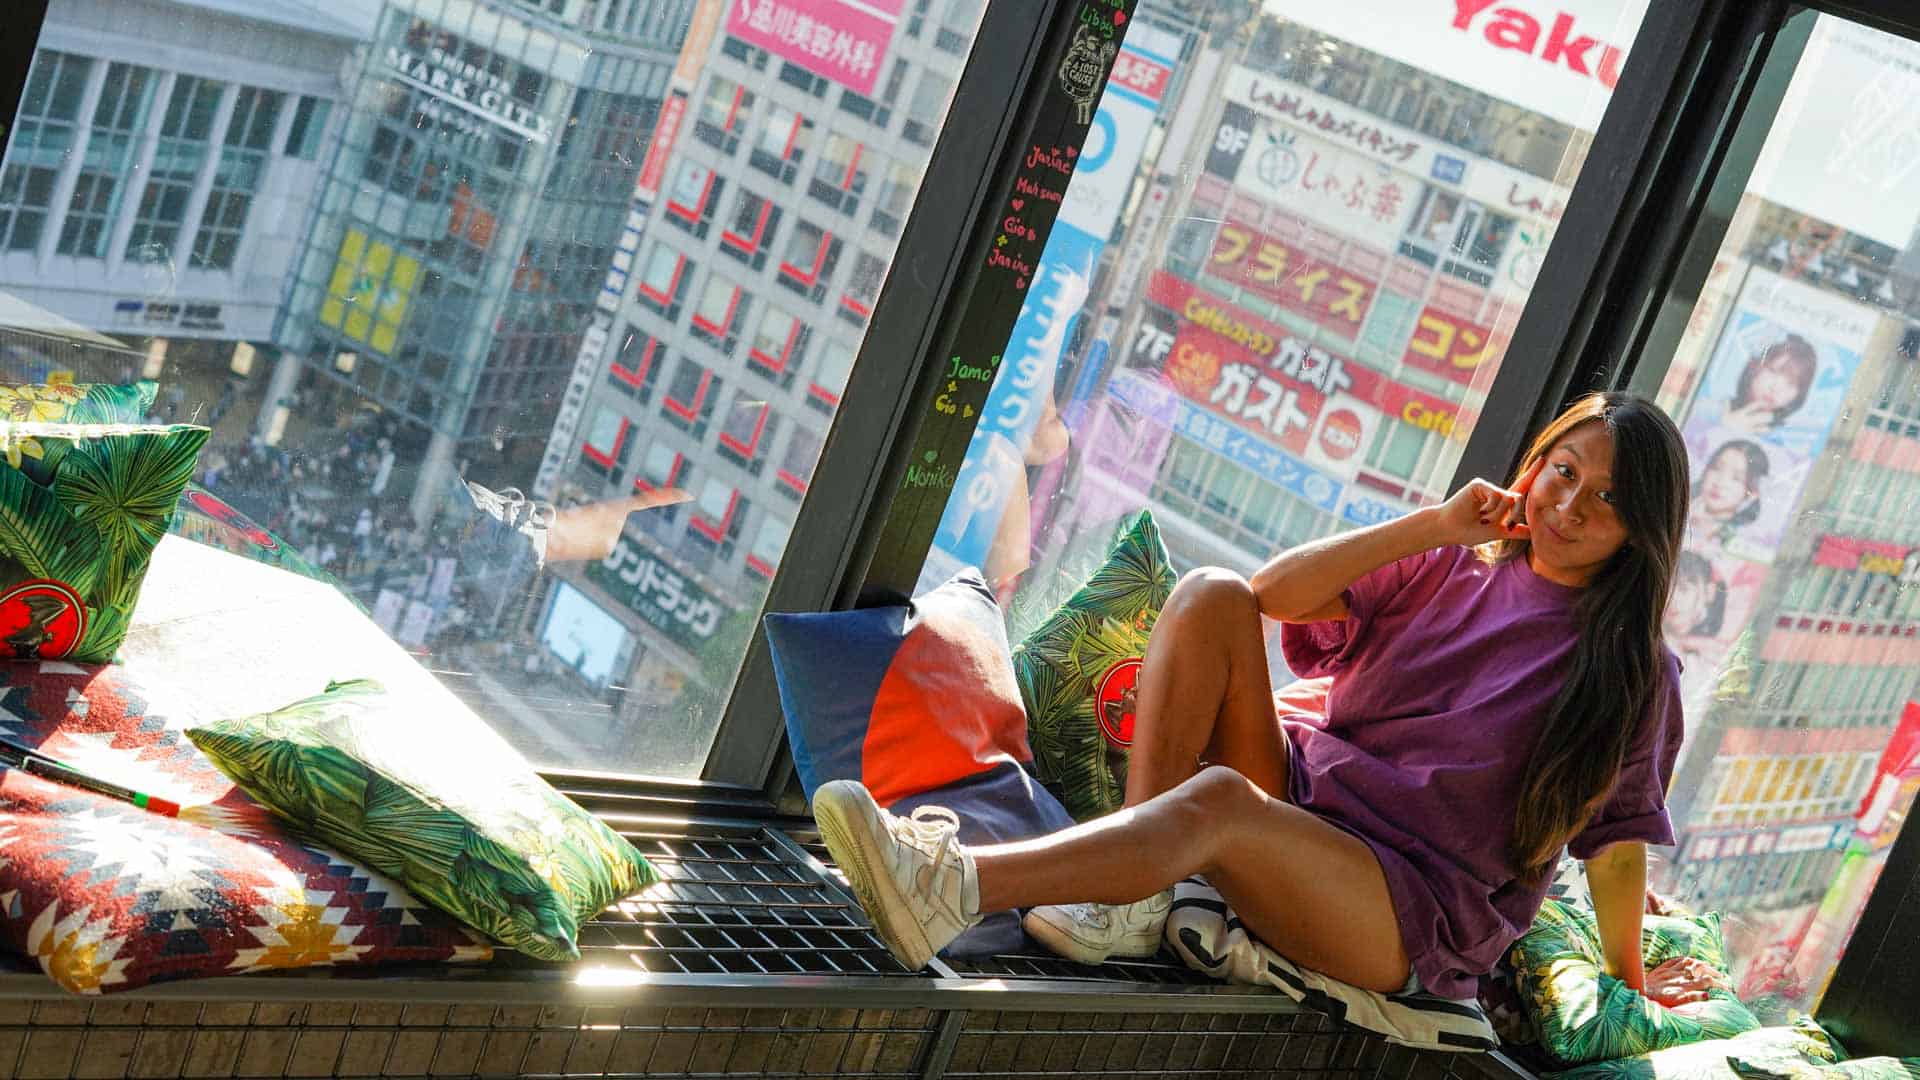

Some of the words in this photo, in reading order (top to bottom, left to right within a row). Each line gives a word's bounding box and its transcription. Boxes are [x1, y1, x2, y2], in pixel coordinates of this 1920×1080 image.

[385, 46, 468, 99] MARK
[479, 89, 552, 138] CITY
[1216, 124, 1249, 156] 9F
[1004, 216, 1026, 237] Gio
[1136, 322, 1176, 360] 7F
[1270, 337, 1355, 396] ガスト
[936, 394, 956, 415] Gio
[1210, 362, 1310, 437] ガスト
